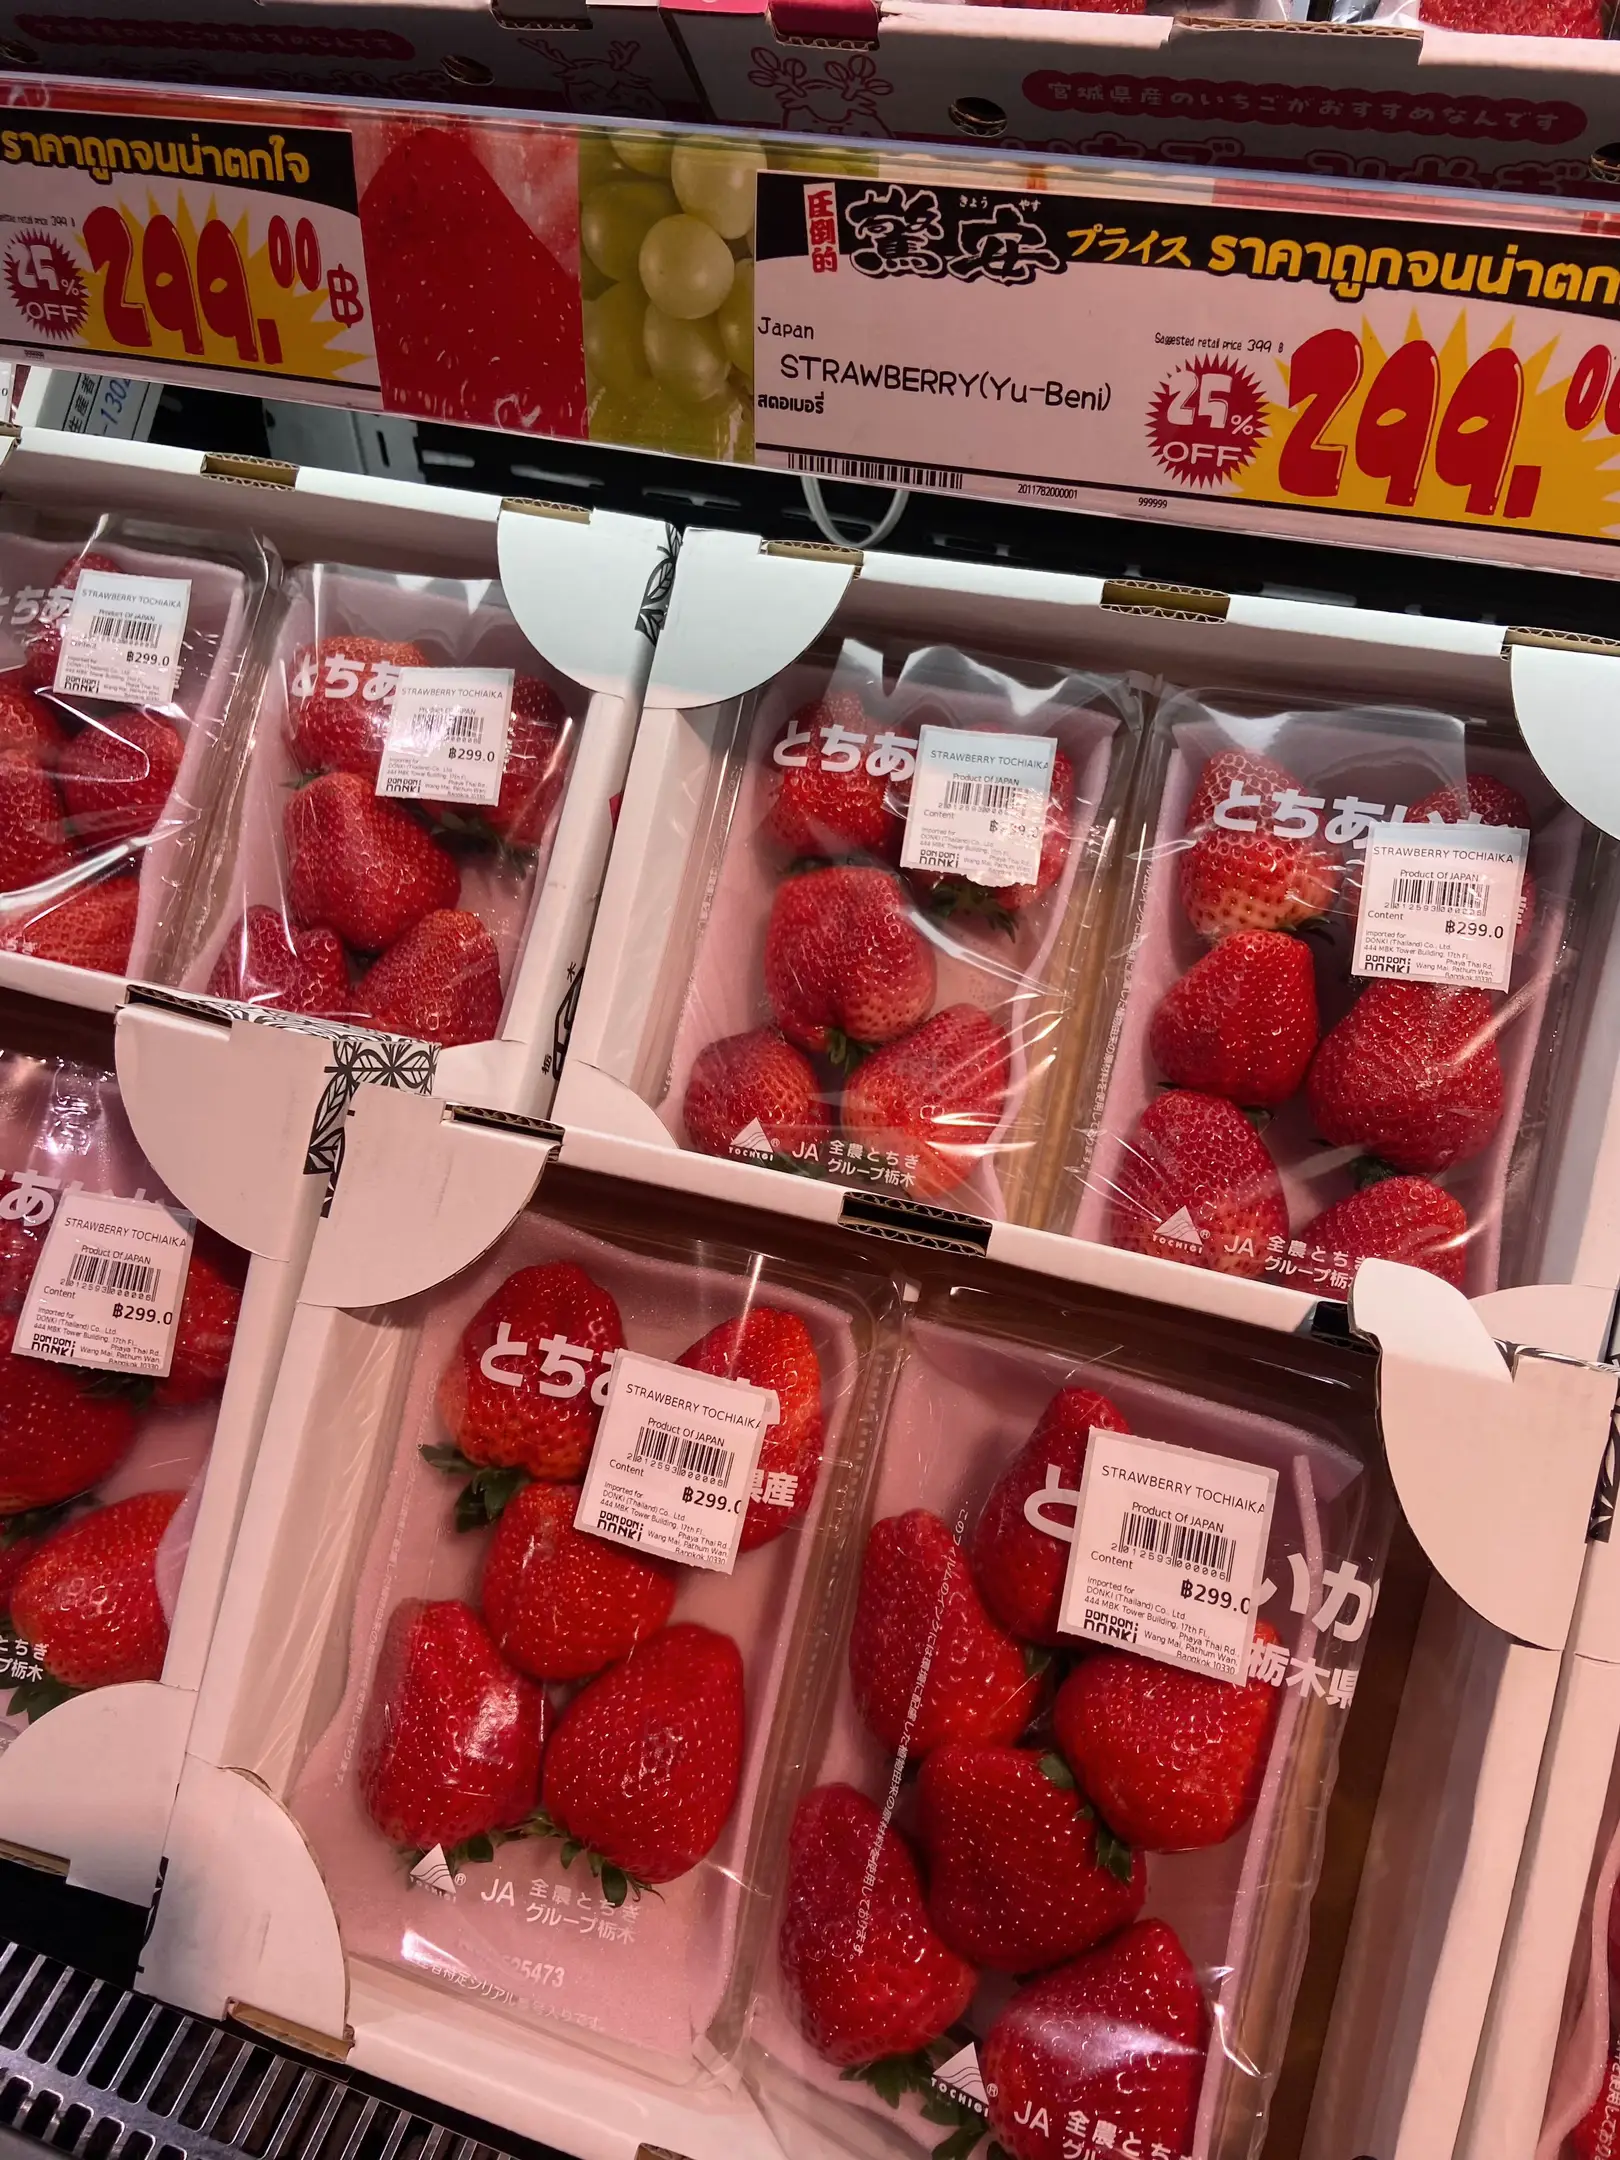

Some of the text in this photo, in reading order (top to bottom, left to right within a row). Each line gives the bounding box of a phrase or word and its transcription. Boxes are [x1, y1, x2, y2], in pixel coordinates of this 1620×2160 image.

[807, 190, 836, 273] 圧倒的
[1066, 223, 1192, 269] プライス
[25, 301, 80, 324] OFF
[757, 317, 815, 341] Japan
[1197, 338, 1220, 349] retail
[1222, 340, 1242, 351] price
[1247, 339, 1272, 353] 399
[780, 354, 1112, 412] STRAWBERRY(Yu-Beni)
[1162, 440, 1243, 468] OFF
[1017, 483, 1079, 499] 2011782000001
[1138, 496, 1168, 509] 999999
[401, 687, 504, 700] STRAWBERRY TOCHIAIKA
[930, 750, 1049, 770] STRAWBERRY TOCHIAIKA
[1373, 846, 1514, 864] STRAWBERRY TOCHIAIKA
[1400, 869, 1479, 882] Product Of JAPAN
[1368, 910, 1404, 921] Content
[729, 1146, 773, 1162] TOCHIGI
[792, 1141, 819, 1161] JA
[829, 1140, 920, 1169] 全農とちぎ
[828, 1159, 916, 1188] グループ栃木
[64, 1217, 187, 1247] STRAWBERRY TOCHIAIKA
[81, 1244, 151, 1265] Product Of JAPAN
[1152, 1235, 1203, 1254] TOCHIGI
[1224, 1236, 1254, 1257] JA
[1265, 1255, 1354, 1290] グループ栃
[43, 1286, 76, 1300] Content
[626, 1383, 700, 1414] STRAWBERRY
[648, 1417, 725, 1447] Product Of JAPAN
[609, 1459, 644, 1477] Content
[1101, 1465, 1265, 1515] STRAWBERRY TOCHIAIKA
[1132, 1501, 1224, 1534] Product Of JAPAN
[1090, 1550, 1133, 1570] Content
[1086, 1585, 1114, 1598] DONKI
[1087, 1576, 1135, 1594] Imported for
[1084, 1595, 1100, 1606] 444
[1101, 1599, 1120, 1612] MBK
[1122, 1606, 1145, 1619] Tower
[1181, 1623, 1197, 1634] 17th
[1144, 1630, 1166, 1645] Wang
[1185, 1643, 1216, 1659] Pathum
[1179, 1631, 1203, 1646] Phaya
[1205, 1638, 1223, 1651] Thai
[1213, 1661, 1236, 1675] 10330
[481, 1879, 515, 1907] JA
[526, 1902, 636, 1945] グループ栃木
[930, 2077, 989, 2118] TOCHIGI
[1014, 2101, 1050, 2138] JA
[1065, 2109, 1192, 2160] 全農とち
